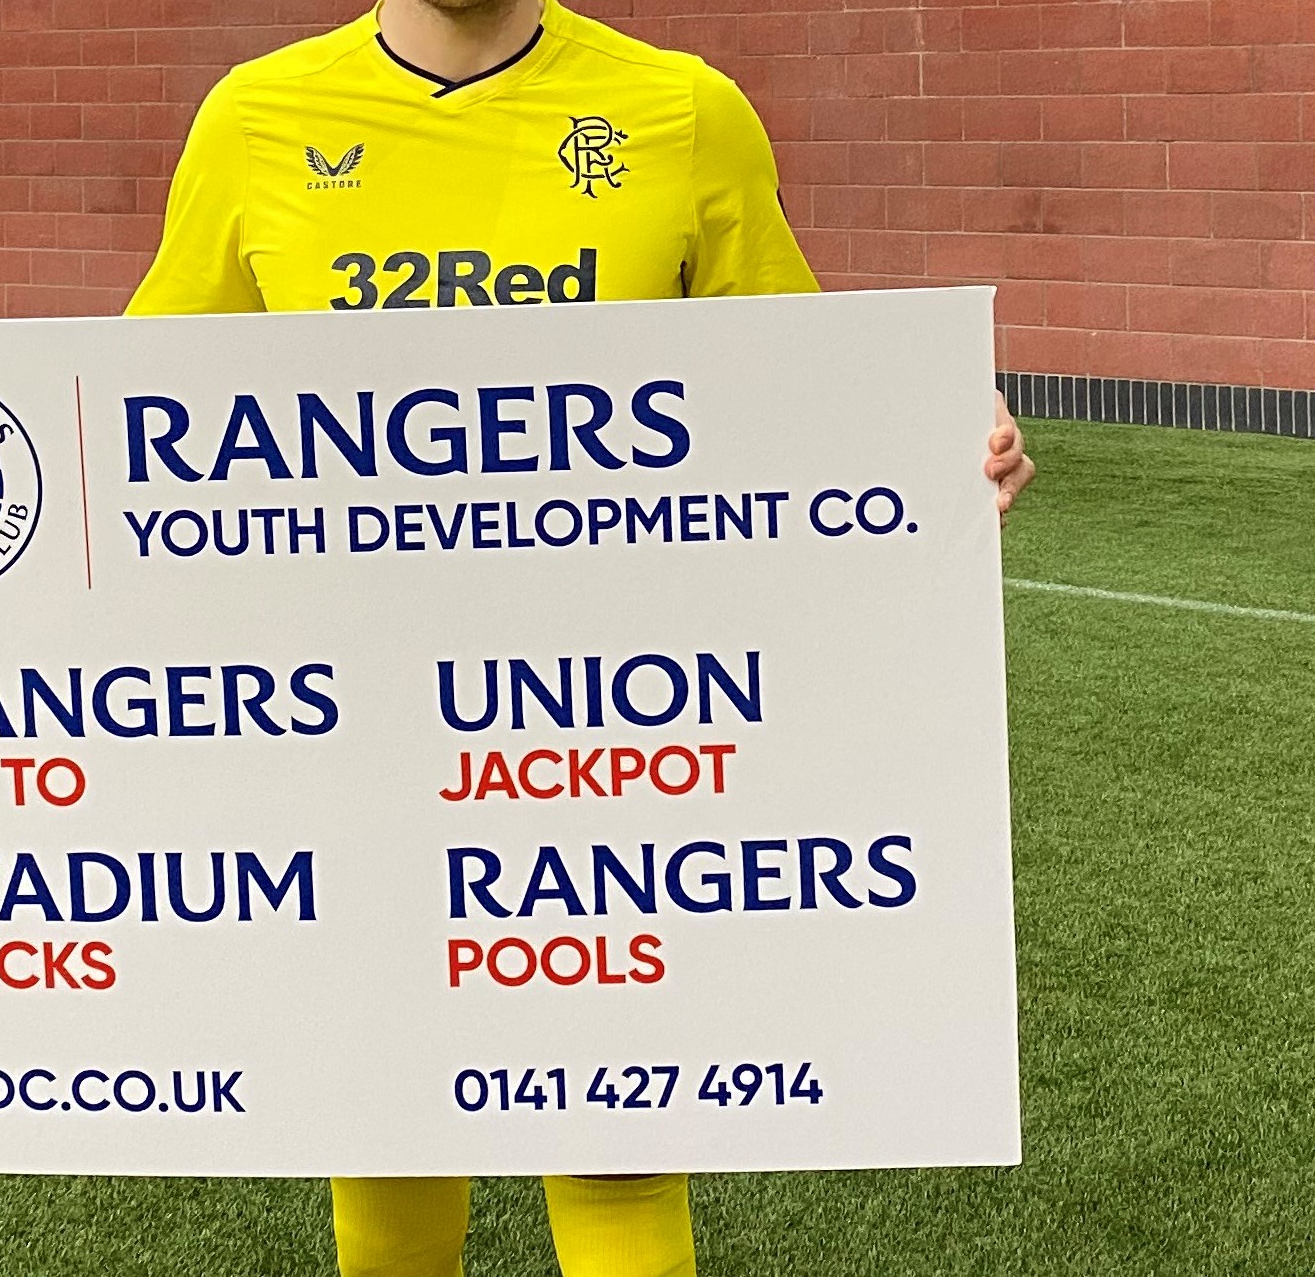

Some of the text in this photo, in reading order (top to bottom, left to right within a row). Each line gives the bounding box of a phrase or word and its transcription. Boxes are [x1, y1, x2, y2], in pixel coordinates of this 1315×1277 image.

[306, 179, 362, 190] CASTORE
[329, 248, 598, 311] 32Red
[123, 379, 691, 483] RANGERS
[123, 486, 919, 558] YOUTH DEVELOPMENT CO.
[437, 650, 763, 732] UNION
[438, 744, 736, 801] JACKPOT
[446, 835, 917, 919] RANGERS
[447, 934, 665, 987] POOLS
[453, 1061, 824, 1112] 0141 427 4914
